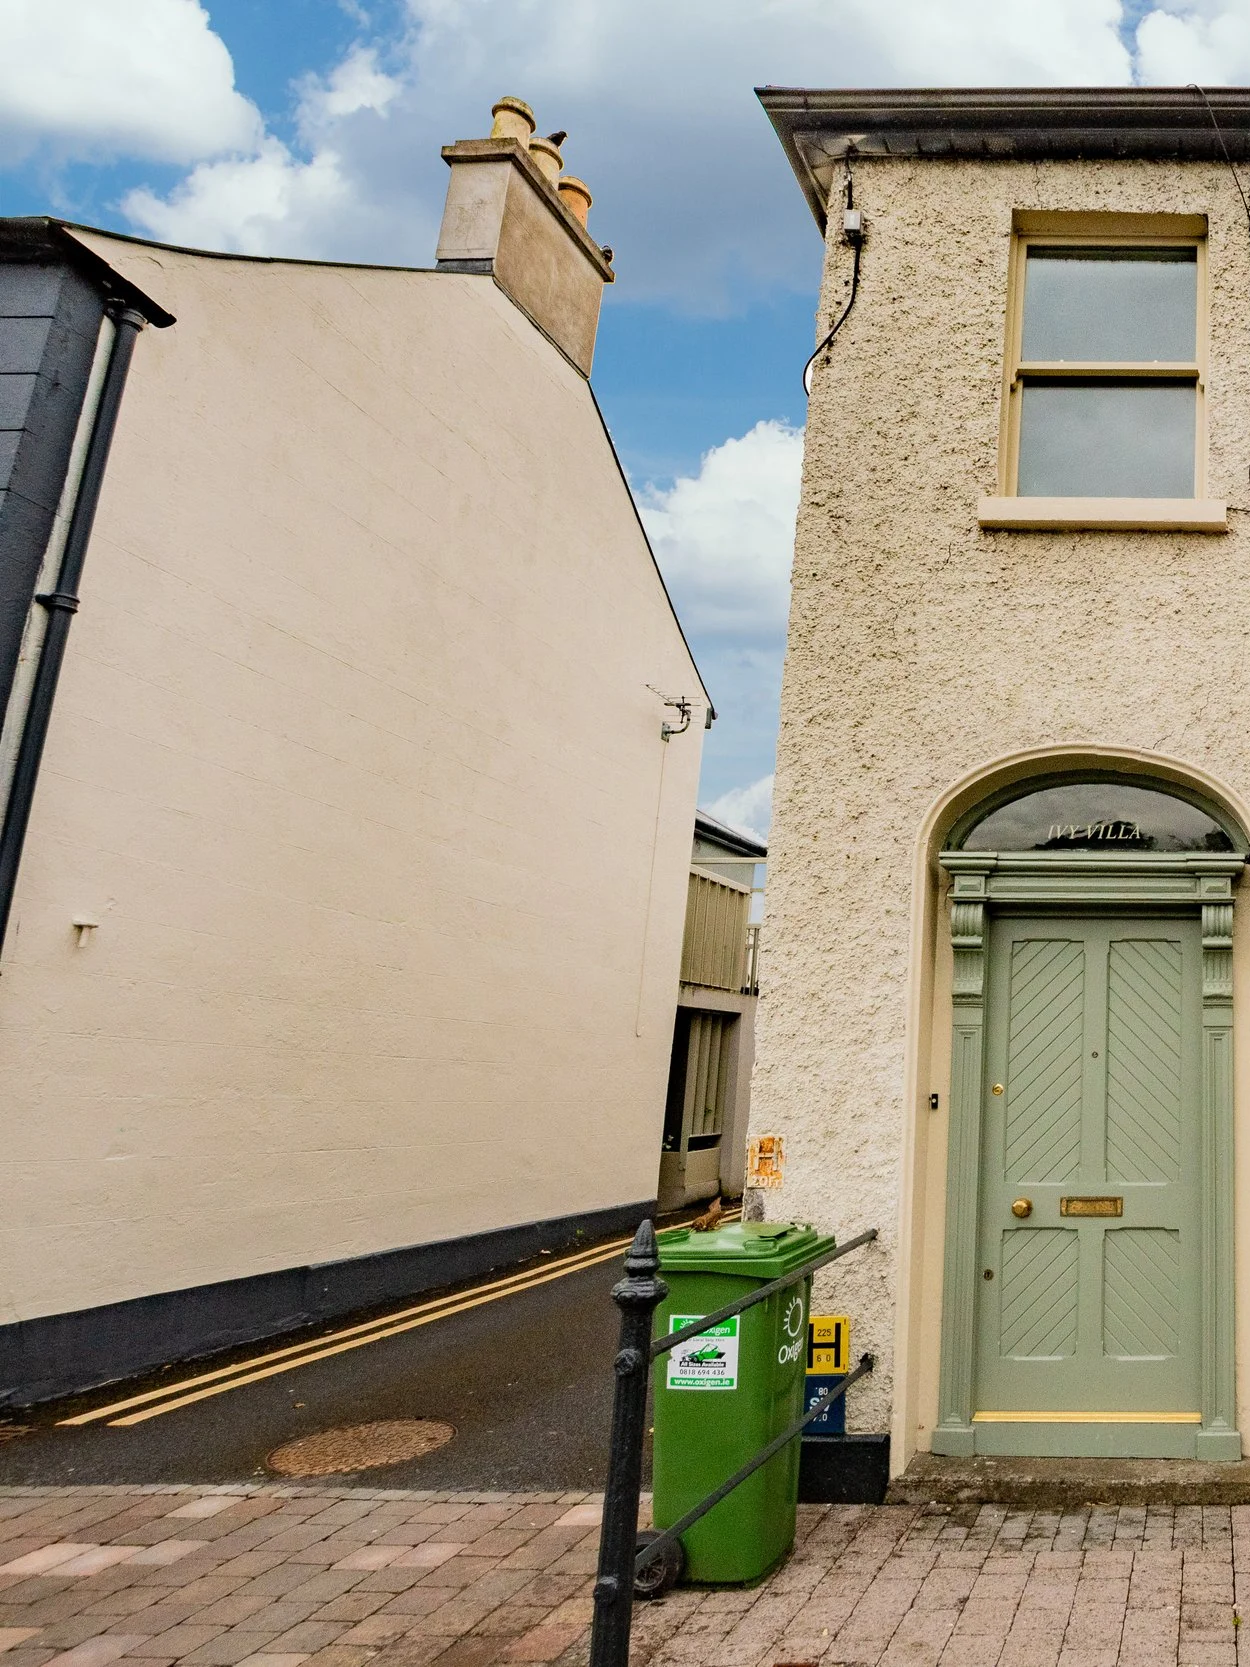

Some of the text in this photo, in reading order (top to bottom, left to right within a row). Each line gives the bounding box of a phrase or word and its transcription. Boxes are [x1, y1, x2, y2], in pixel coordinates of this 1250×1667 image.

[1048, 825, 1141, 839] IVY VILLA
[817, 1329, 831, 1337] 225
[807, 1323, 841, 1368] H
[674, 1379, 730, 1387] www.oxigen.ie
